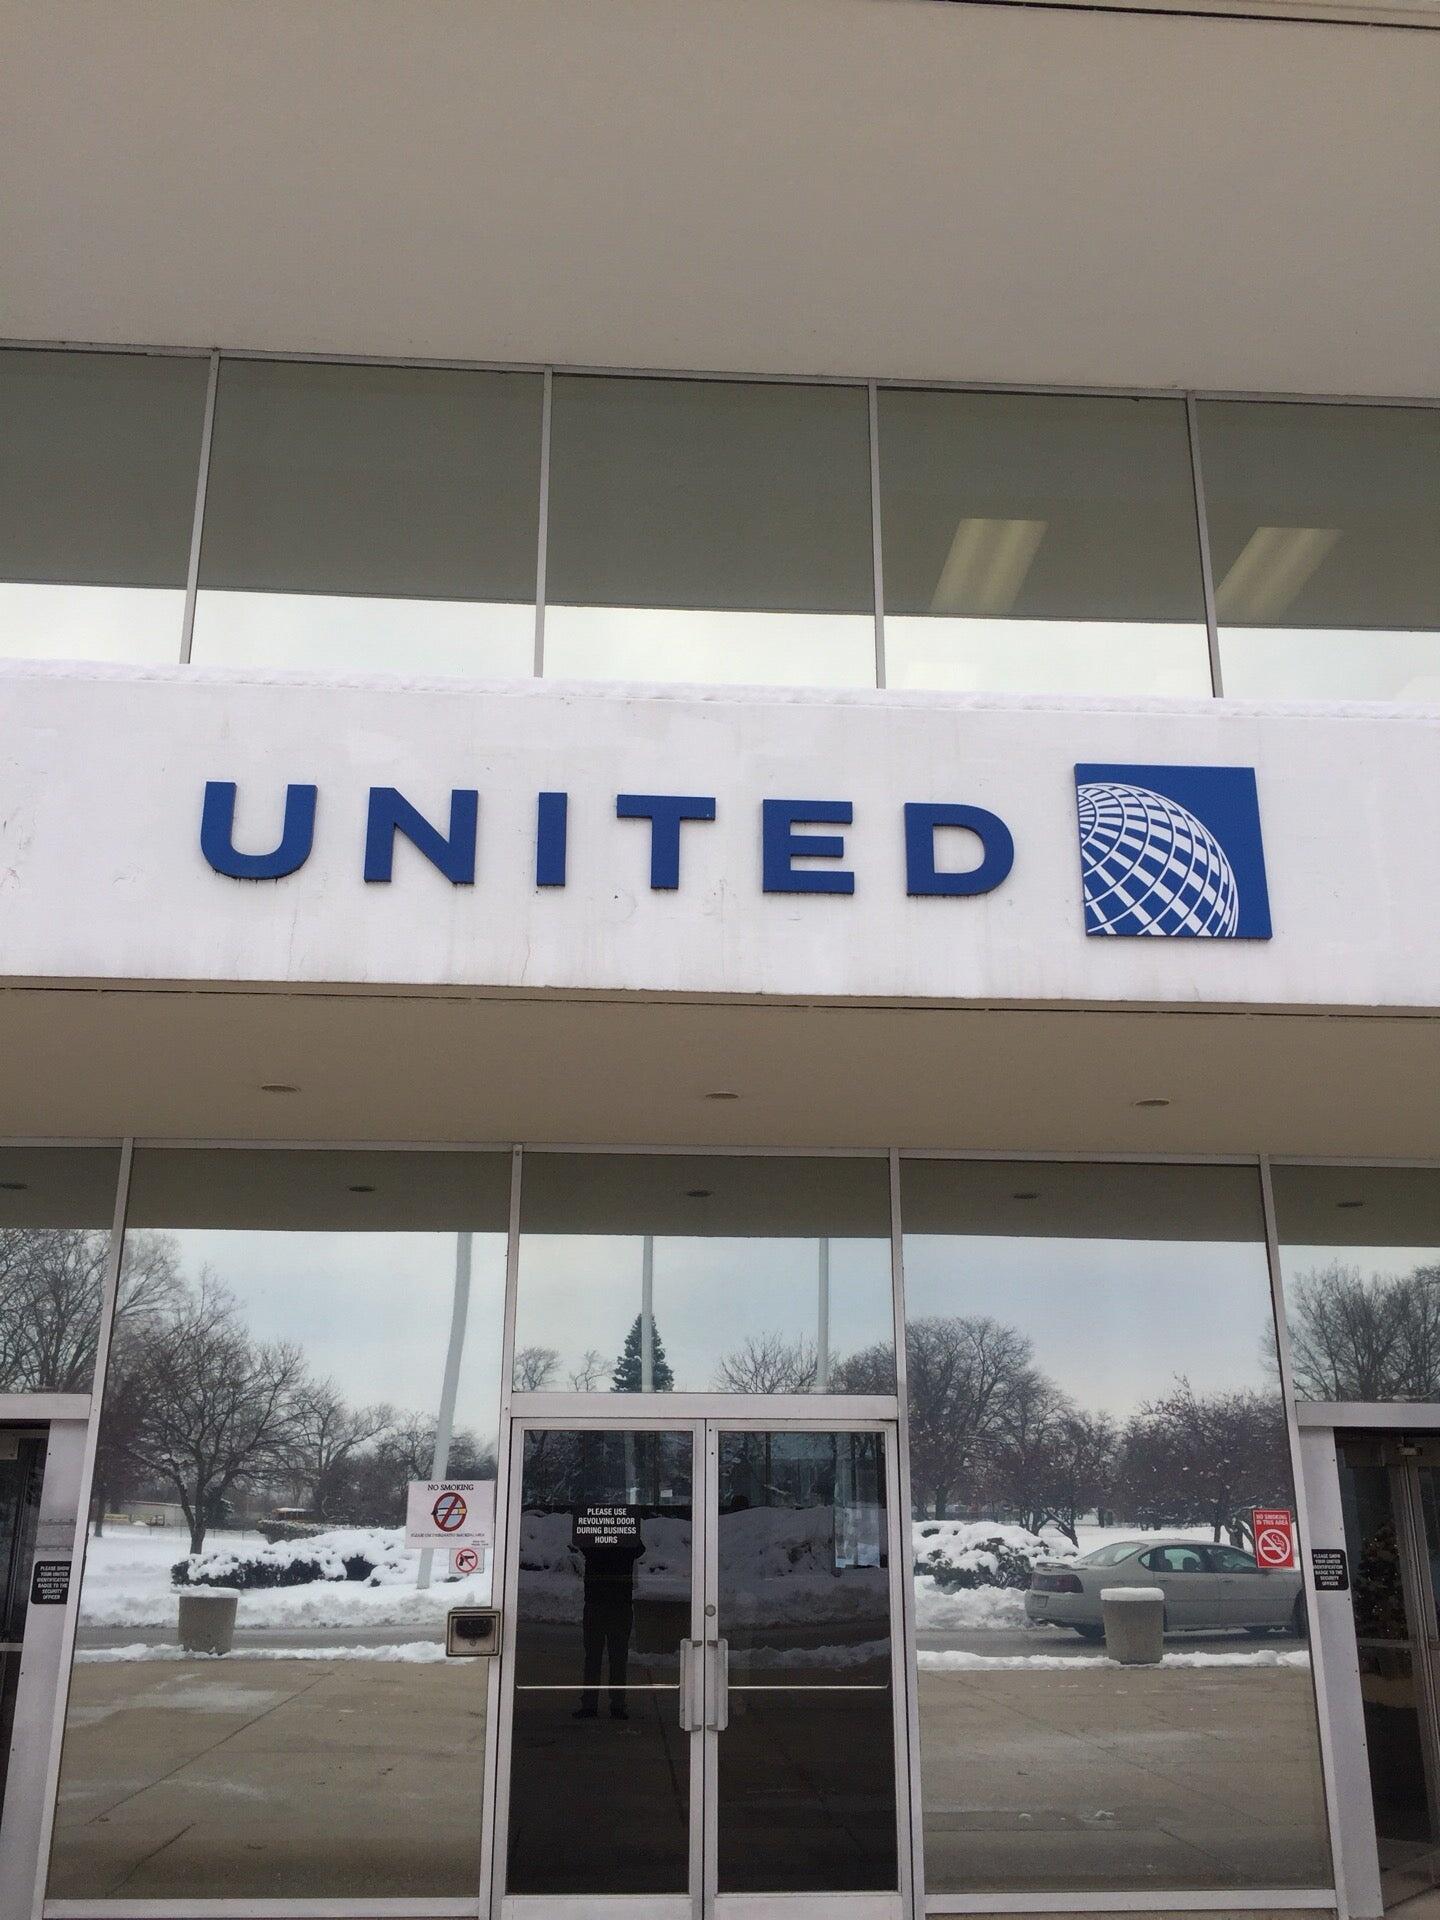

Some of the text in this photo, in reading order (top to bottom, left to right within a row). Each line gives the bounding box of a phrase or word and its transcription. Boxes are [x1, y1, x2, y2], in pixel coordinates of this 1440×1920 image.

[200, 781, 1015, 896] UNITED
[578, 1517, 635, 1525] REVOLVING DOOR
[576, 1526, 637, 1534] DURING BUSINESS
